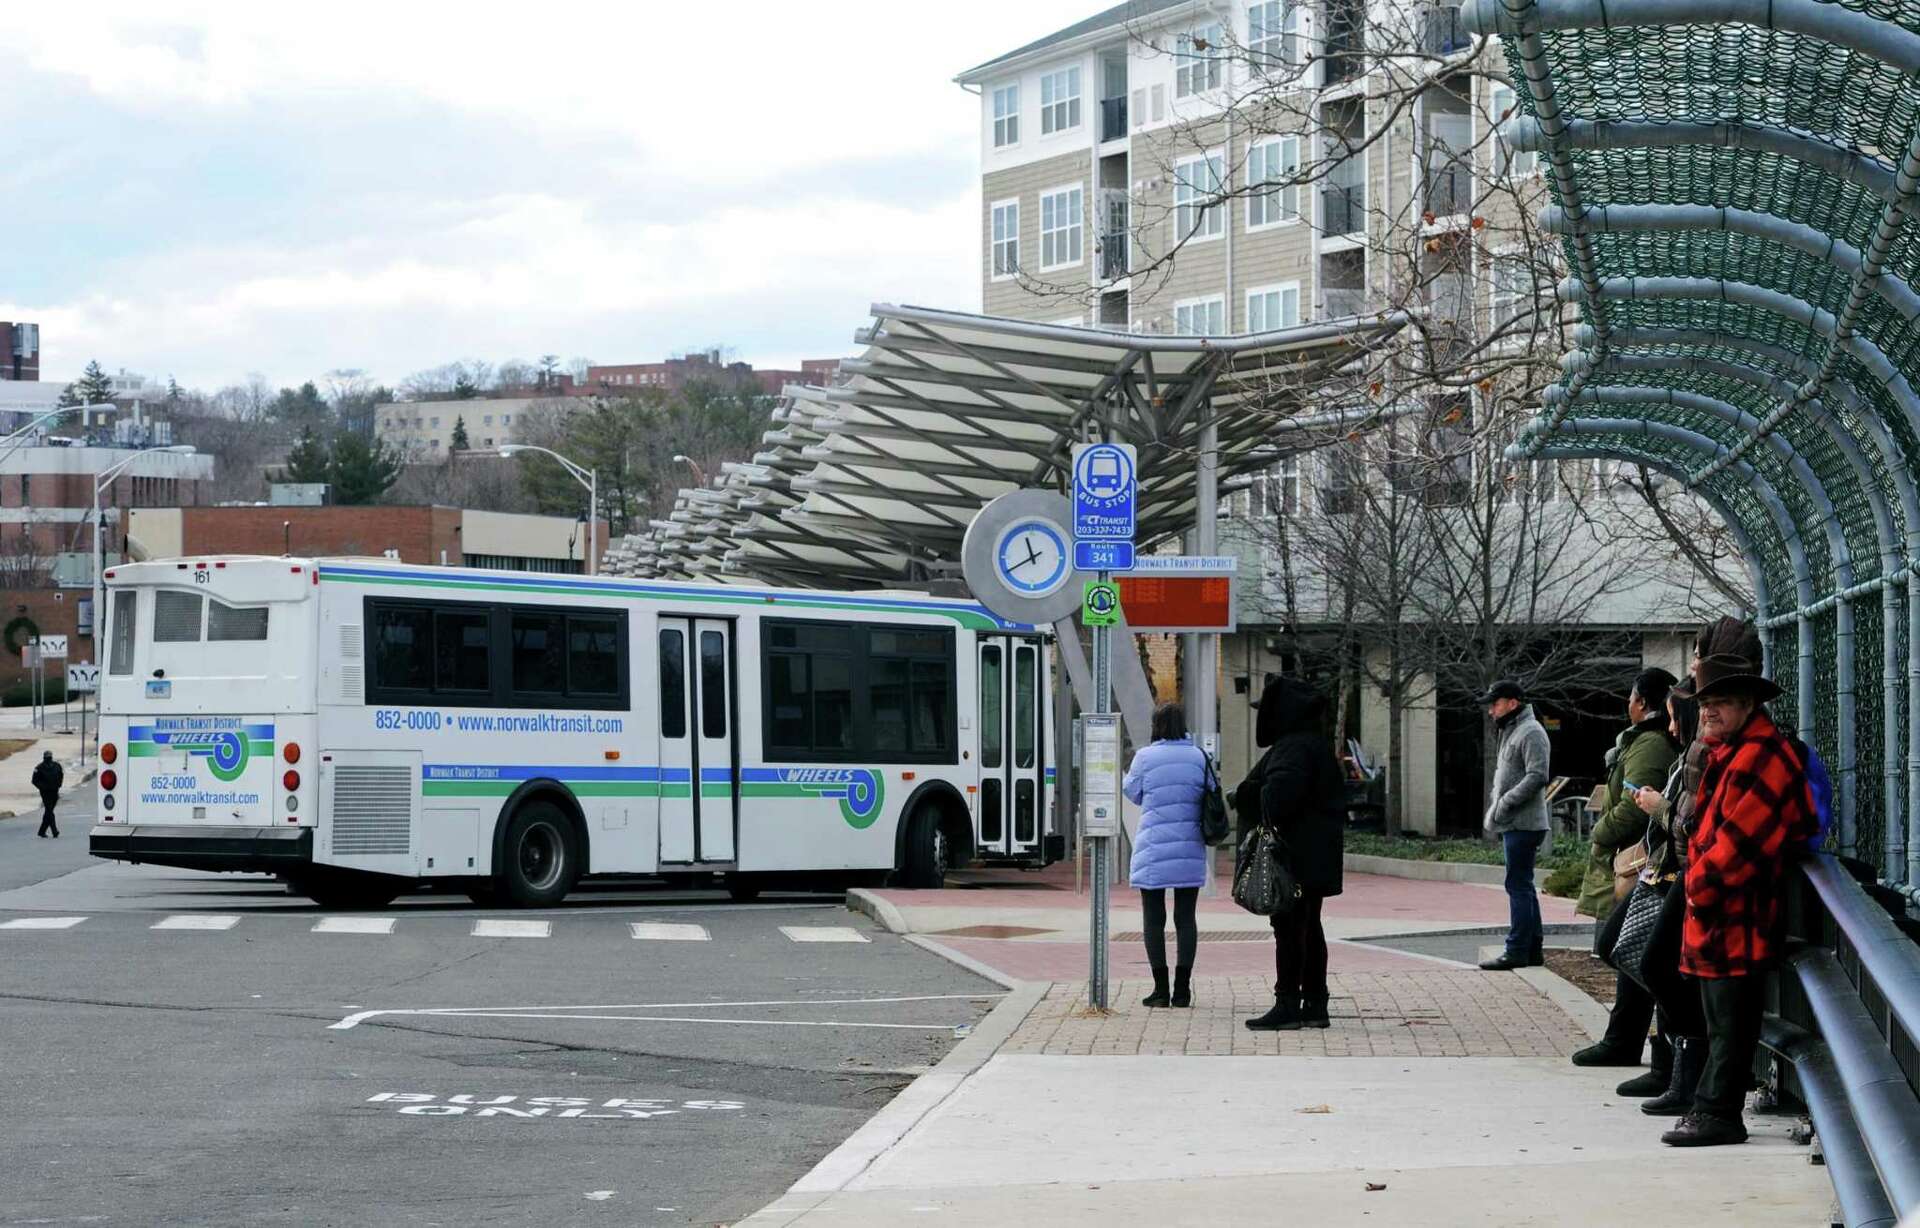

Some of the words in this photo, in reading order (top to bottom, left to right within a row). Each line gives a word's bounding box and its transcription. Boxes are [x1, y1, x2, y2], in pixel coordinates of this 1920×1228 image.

[1078, 492, 1100, 508] BUS
[1105, 490, 1130, 508] STOP
[1092, 552, 1114, 563] 341
[1170, 558, 1198, 568] TRANSIT
[1201, 558, 1232, 568] DISTRICT
[194, 571, 210, 584] 161
[186, 717, 212, 728] TRANSIT
[214, 717, 242, 728] DISTRICT
[376, 710, 441, 730] 852-0000
[458, 713, 623, 734] www.norwalktransit.com
[168, 733, 225, 744] WHEELS
[786, 769, 854, 782] WHEELS
[151, 776, 196, 790] 852-0000
[141, 791, 259, 804] www.norwalktransit.com
[366, 1092, 746, 1110] BUSES
[398, 1105, 681, 1118] ONLY
